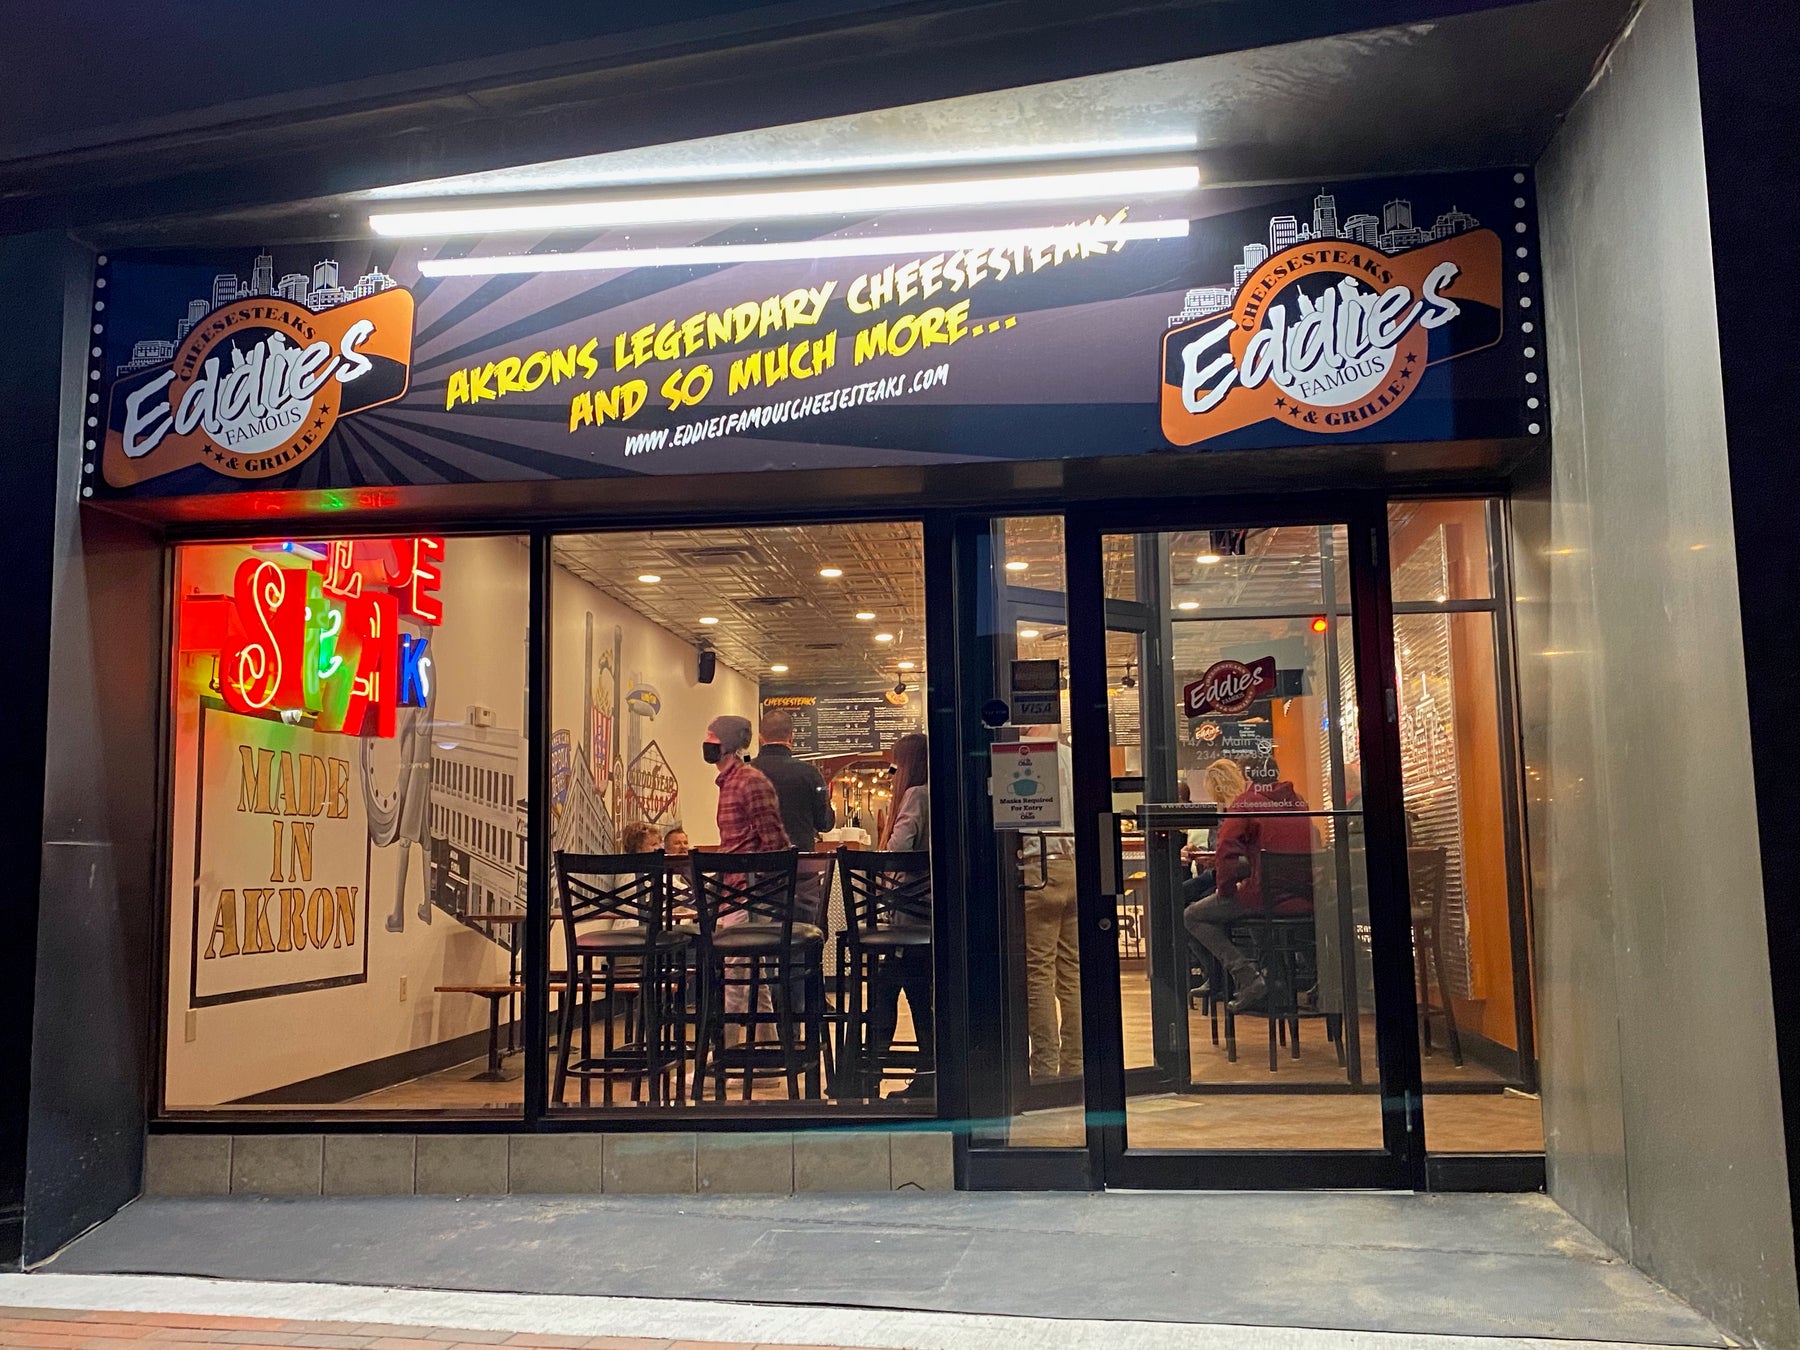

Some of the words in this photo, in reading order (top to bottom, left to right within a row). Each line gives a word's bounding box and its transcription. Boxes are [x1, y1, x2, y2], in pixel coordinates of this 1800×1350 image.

[1241, 250, 1394, 333] CHEESESTEAKS
[180, 307, 317, 382] CHEESESTEAKS
[446, 336, 600, 412] AKRONS
[615, 279, 838, 373] LEGENDARY
[569, 378, 649, 434] AND
[660, 364, 714, 412] SO
[728, 329, 838, 396] MUCH
[853, 297, 1018, 367] MORE...
[1181, 261, 1462, 414] Eddies
[122, 319, 375, 458] Eddies
[1299, 355, 1386, 399] FAMOUS
[1302, 409, 1320, 425] &
[1324, 378, 1407, 427] GRILLE
[225, 407, 302, 446] FAMOUS
[225, 456, 239, 469] &
[244, 430, 318, 472] GRILLE
[1020, 703, 1052, 714] VISA
[1190, 666, 1264, 709] Eddies
[1221, 736, 1251, 747] Main
[237, 745, 349, 819] MADE
[1254, 784, 1273, 796] pm
[270, 820, 315, 882] IN
[204, 886, 359, 960] AKRON
